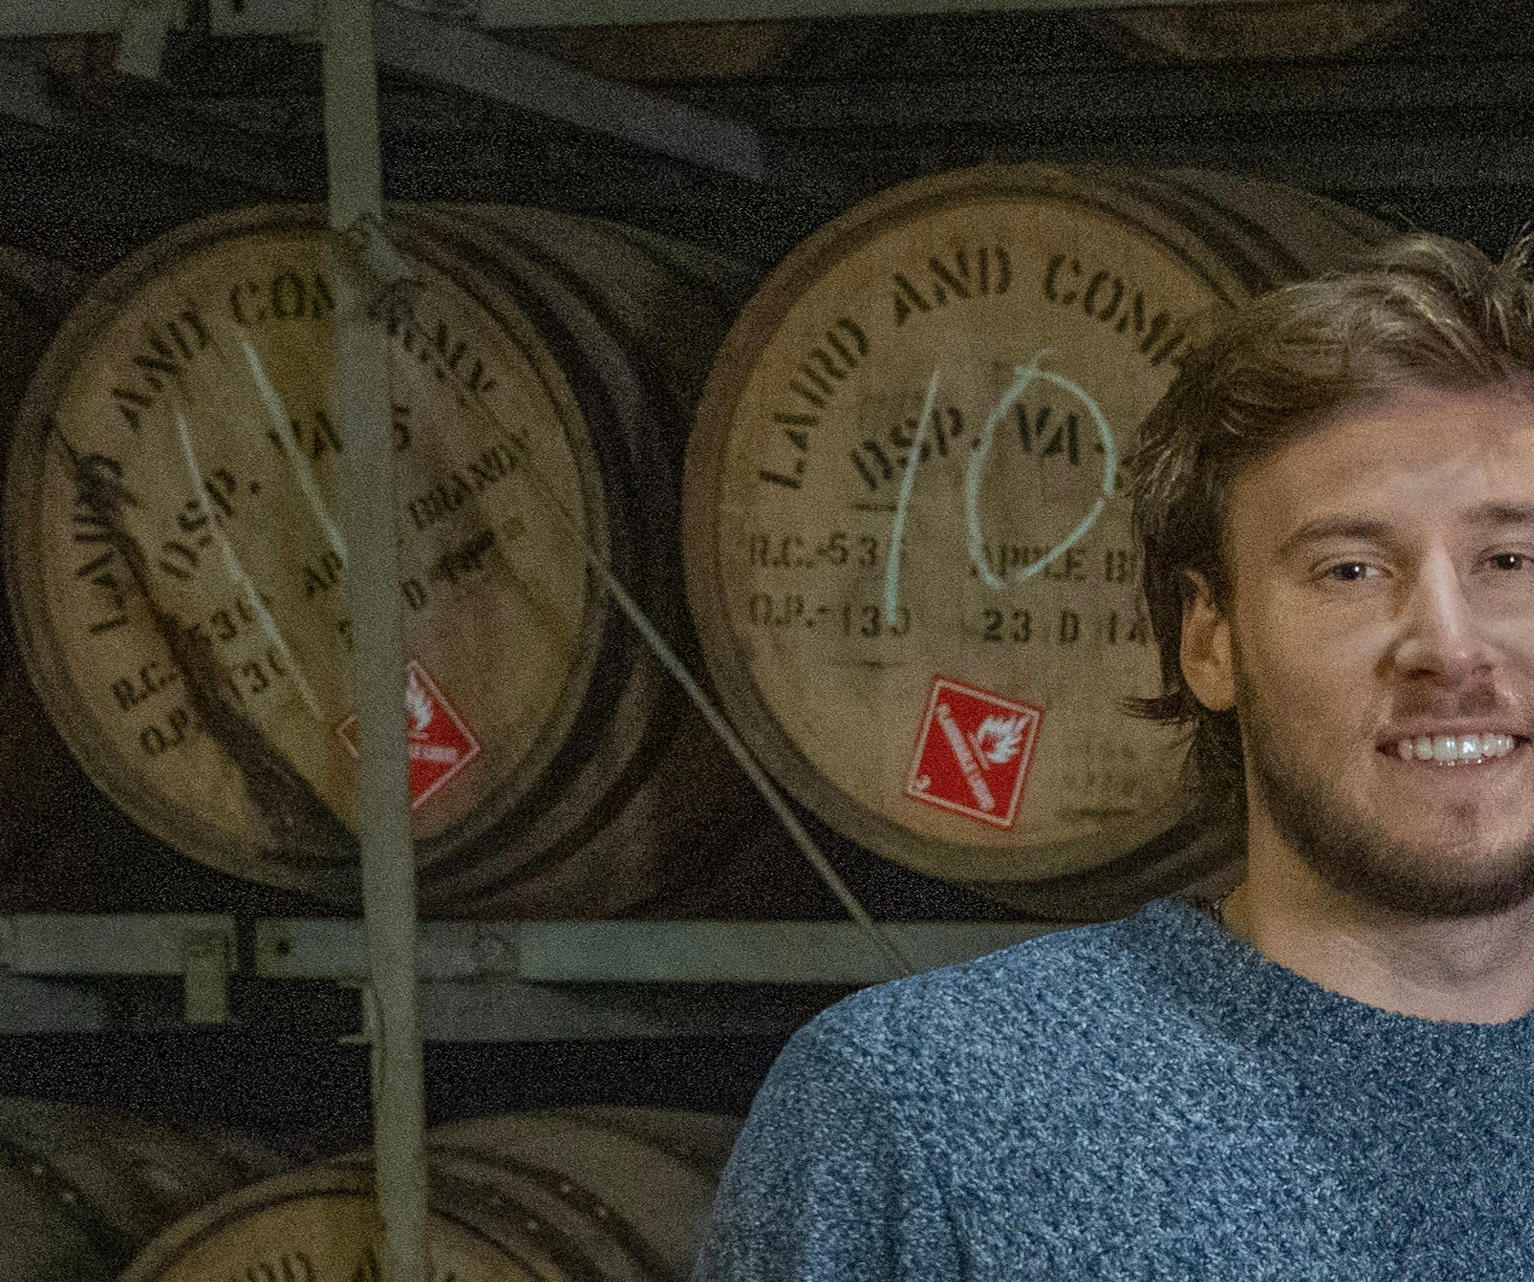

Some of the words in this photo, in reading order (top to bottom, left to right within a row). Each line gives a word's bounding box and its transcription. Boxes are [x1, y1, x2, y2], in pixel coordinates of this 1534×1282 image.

[758, 317, 870, 490] LAIRD
[892, 246, 1013, 327] AND
[885, 347, 1116, 626] 10
[982, 609, 1032, 643] 23
